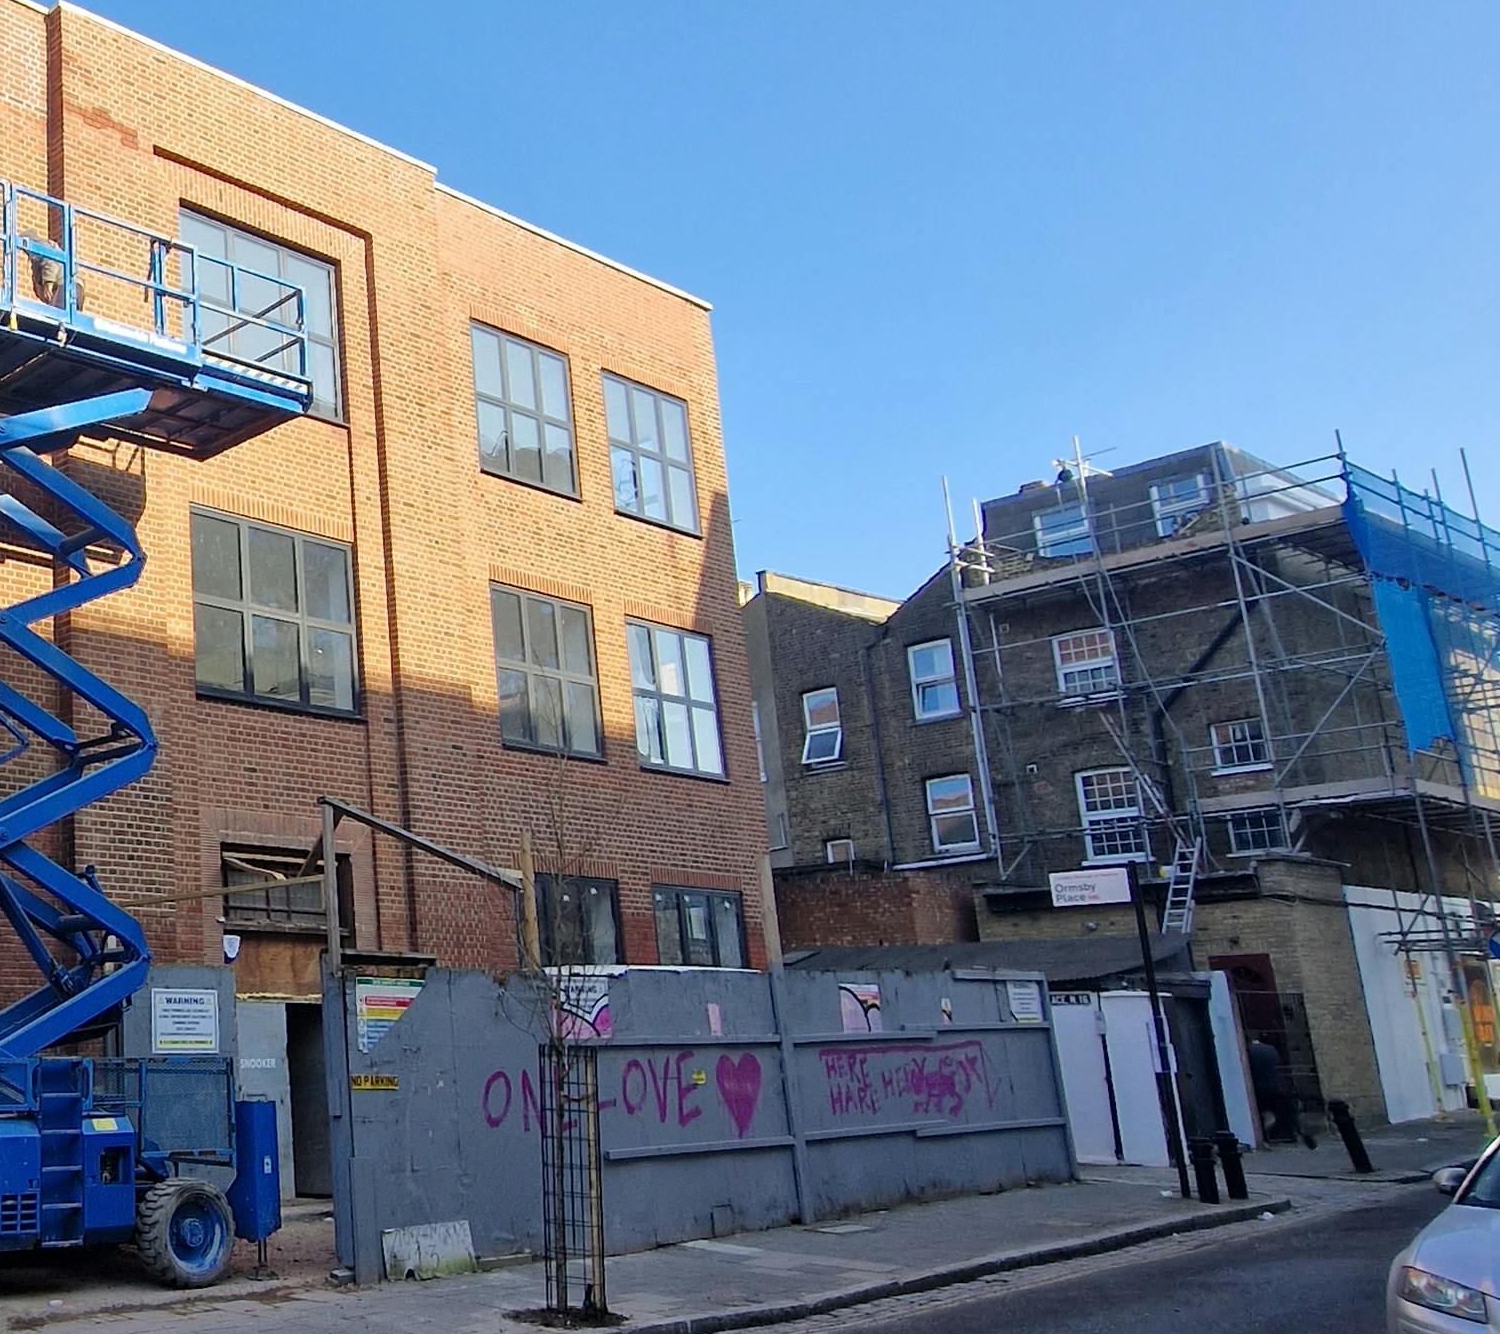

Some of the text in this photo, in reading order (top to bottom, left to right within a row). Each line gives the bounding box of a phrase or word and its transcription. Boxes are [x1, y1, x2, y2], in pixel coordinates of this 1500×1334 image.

[1055, 882, 1097, 893] Ormsby
[1056, 893, 1086, 903] Place
[165, 997, 205, 1005] WARNING
[240, 1058, 276, 1069] SNOOKER
[351, 1074, 399, 1087] NO PARKING
